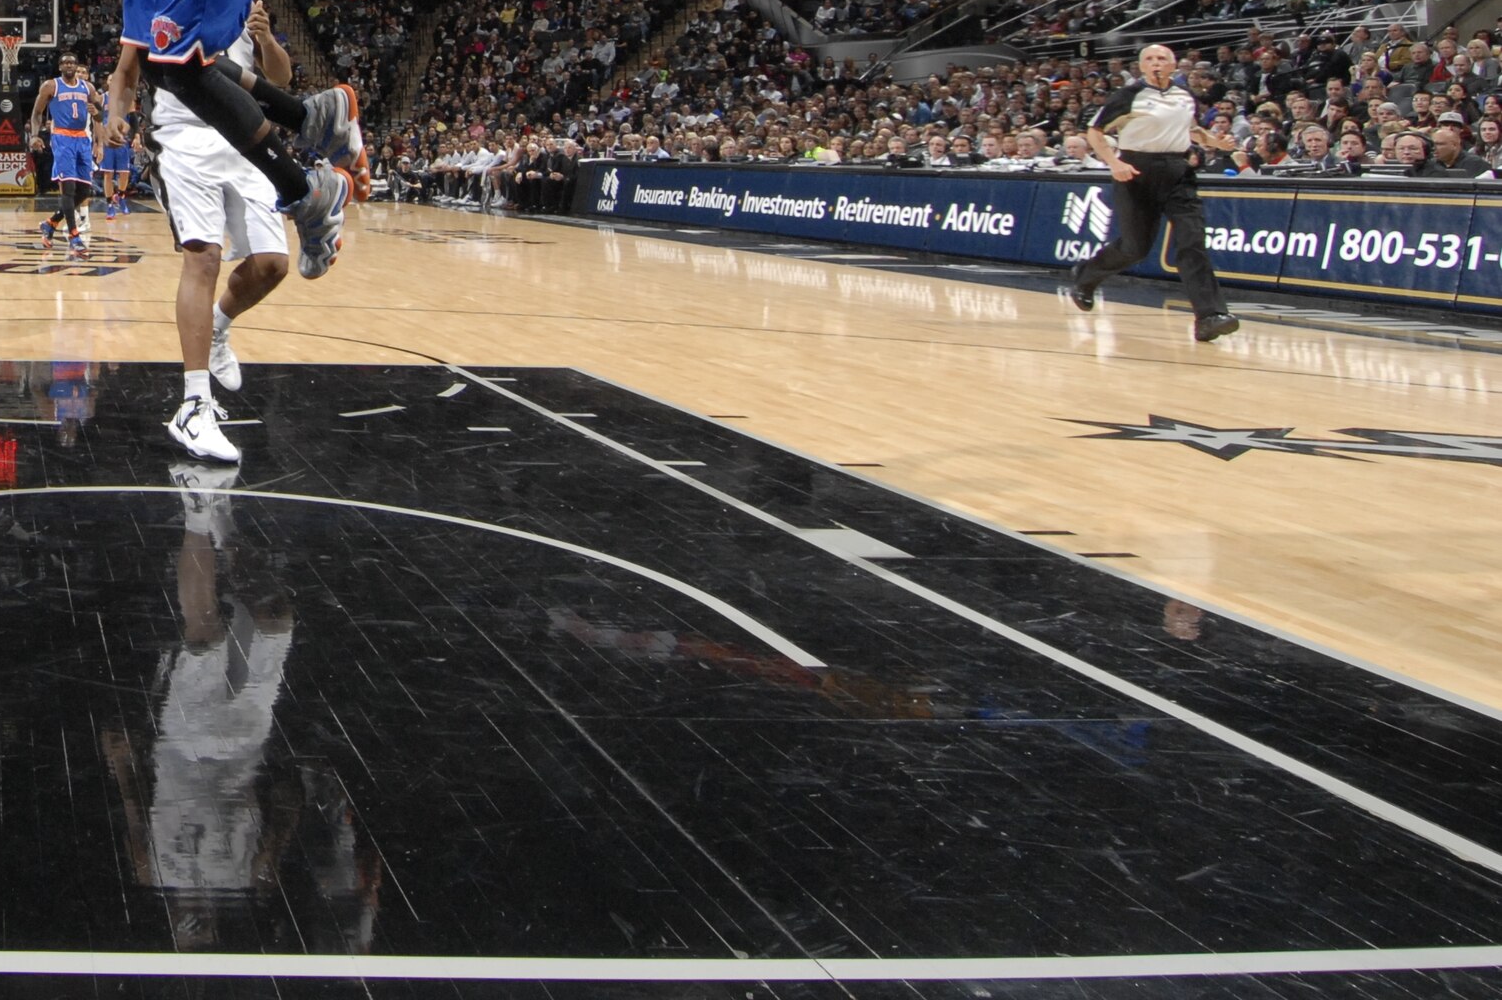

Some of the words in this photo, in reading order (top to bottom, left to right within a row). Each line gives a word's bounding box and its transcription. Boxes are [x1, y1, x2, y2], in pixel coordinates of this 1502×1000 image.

[1080, 43, 1088, 57] 6
[72, 102, 78, 119] 1
[597, 199, 617, 213] USAA
[633, 184, 684, 206] Insurance
[688, 186, 736, 217] Banking
[742, 190, 826, 219] Investments
[834, 196, 931, 229] Retirement
[942, 203, 1015, 236] Advice
